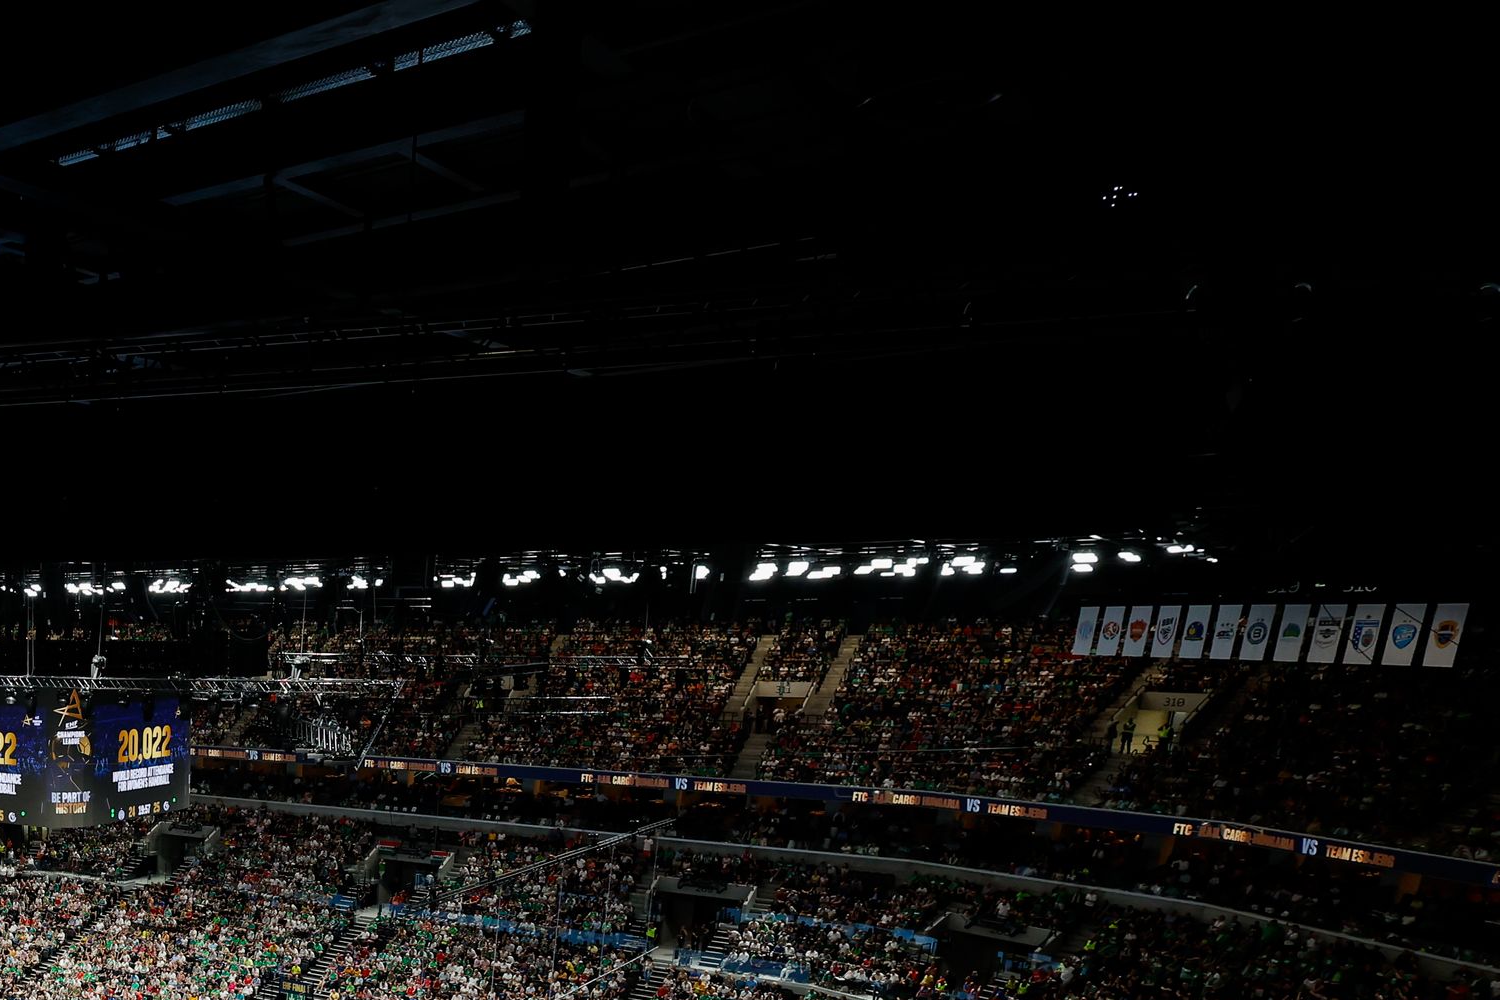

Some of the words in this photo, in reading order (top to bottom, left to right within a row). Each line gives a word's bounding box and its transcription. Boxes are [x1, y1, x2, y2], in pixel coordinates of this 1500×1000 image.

[117, 724, 172, 764] 20,022
[250, 751, 258, 760] VS
[262, 752, 275, 761] TEAM
[112, 769, 130, 782] WORLD
[129, 767, 148, 780] RECORD
[147, 763, 174, 777] ATTENDANCE
[440, 762, 451, 773] VS
[456, 765, 471, 774] TEAM
[117, 781, 127, 792] FOR
[148, 774, 170, 788] HANDBALL
[675, 778, 688, 790] VS
[694, 781, 713, 791] TEAM
[51, 792, 61, 803] BE
[62, 791, 81, 803] PART
[82, 790, 91, 802] OF
[55, 802, 87, 814] HISTORY
[128, 806, 136, 817] 24
[153, 802, 160, 813] 25
[966, 798, 980, 812] VS
[987, 803, 1009, 816] TEAM
[1302, 838, 1318, 856] VS
[1325, 844, 1351, 861] TEAM
